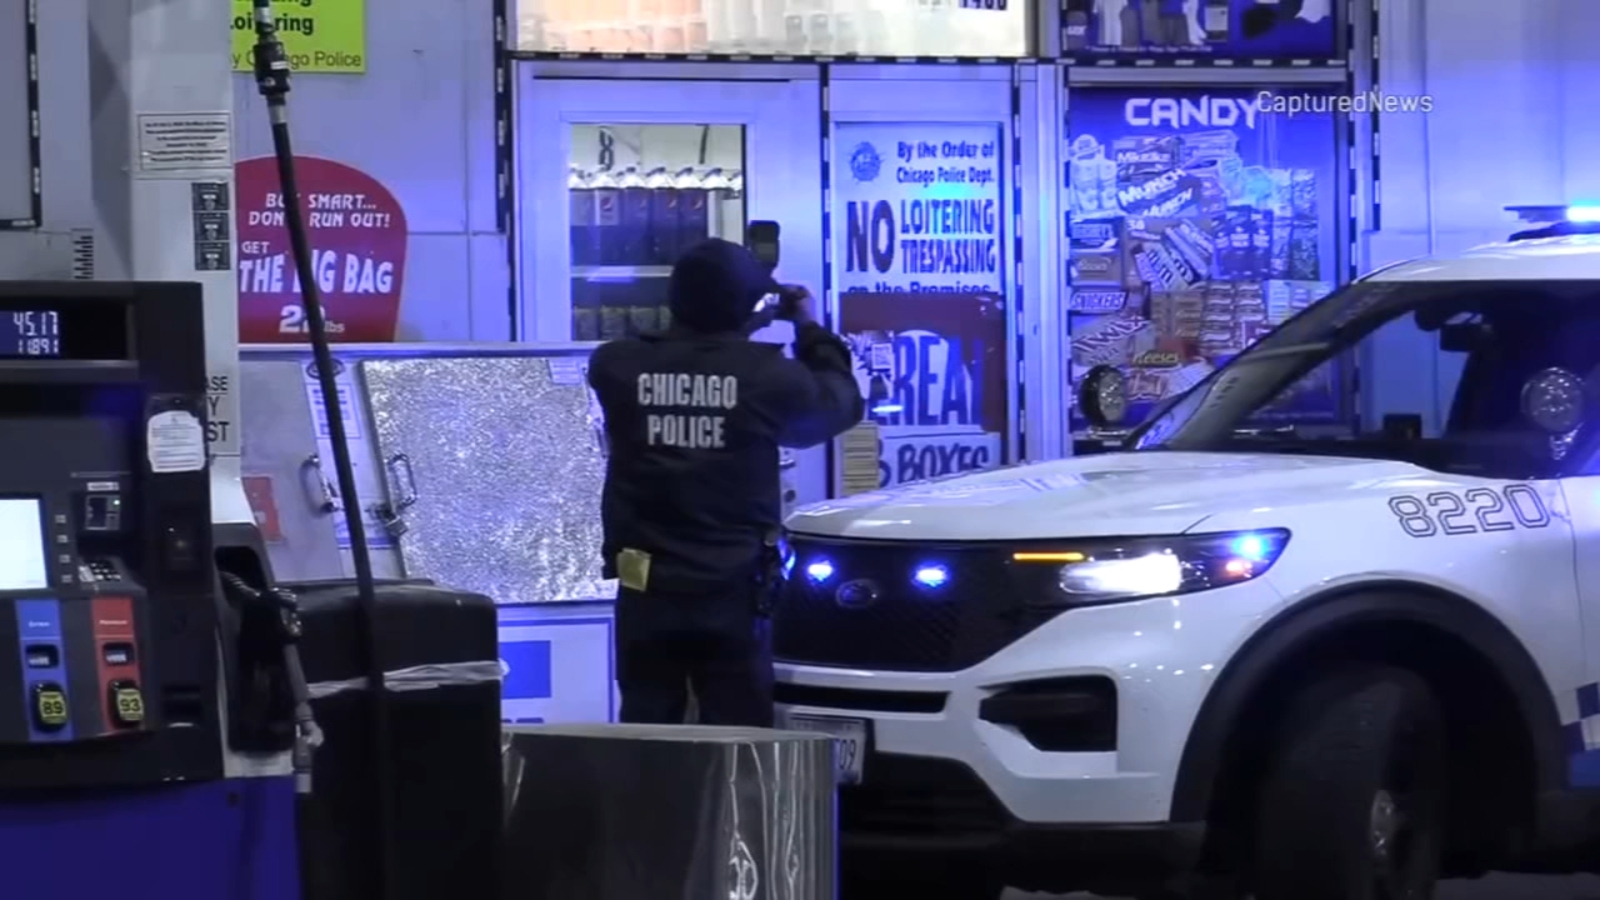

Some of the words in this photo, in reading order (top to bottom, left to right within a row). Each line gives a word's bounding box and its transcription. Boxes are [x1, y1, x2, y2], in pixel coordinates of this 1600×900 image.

[230, 12, 314, 36] oiring
[314, 51, 362, 67] Police
[1124, 95, 1259, 129] CANDY
[898, 141, 914, 163] By
[918, 141, 937, 158] the
[942, 141, 977, 159] Order
[981, 141, 995, 158] of
[897, 167, 935, 188] Chicago
[938, 167, 966, 184] Police
[969, 167, 995, 188] Dept.
[308, 194, 377, 210] SMART...
[249, 211, 285, 226] DON
[309, 212, 344, 228] RUN
[351, 213, 391, 228] OUT!
[900, 199, 995, 235] LOITERING
[241, 241, 270, 254] GET
[846, 200, 896, 274] NO
[900, 238, 996, 274] TRESPASSING
[239, 253, 285, 293] THE
[343, 253, 394, 294] BAG
[207, 375, 228, 391] SE
[637, 372, 738, 410] CHICAGO
[647, 413, 726, 449] POLICE
[1387, 484, 1551, 538] 8220
[42, 700, 64, 715] 89
[119, 698, 141, 712] 93
